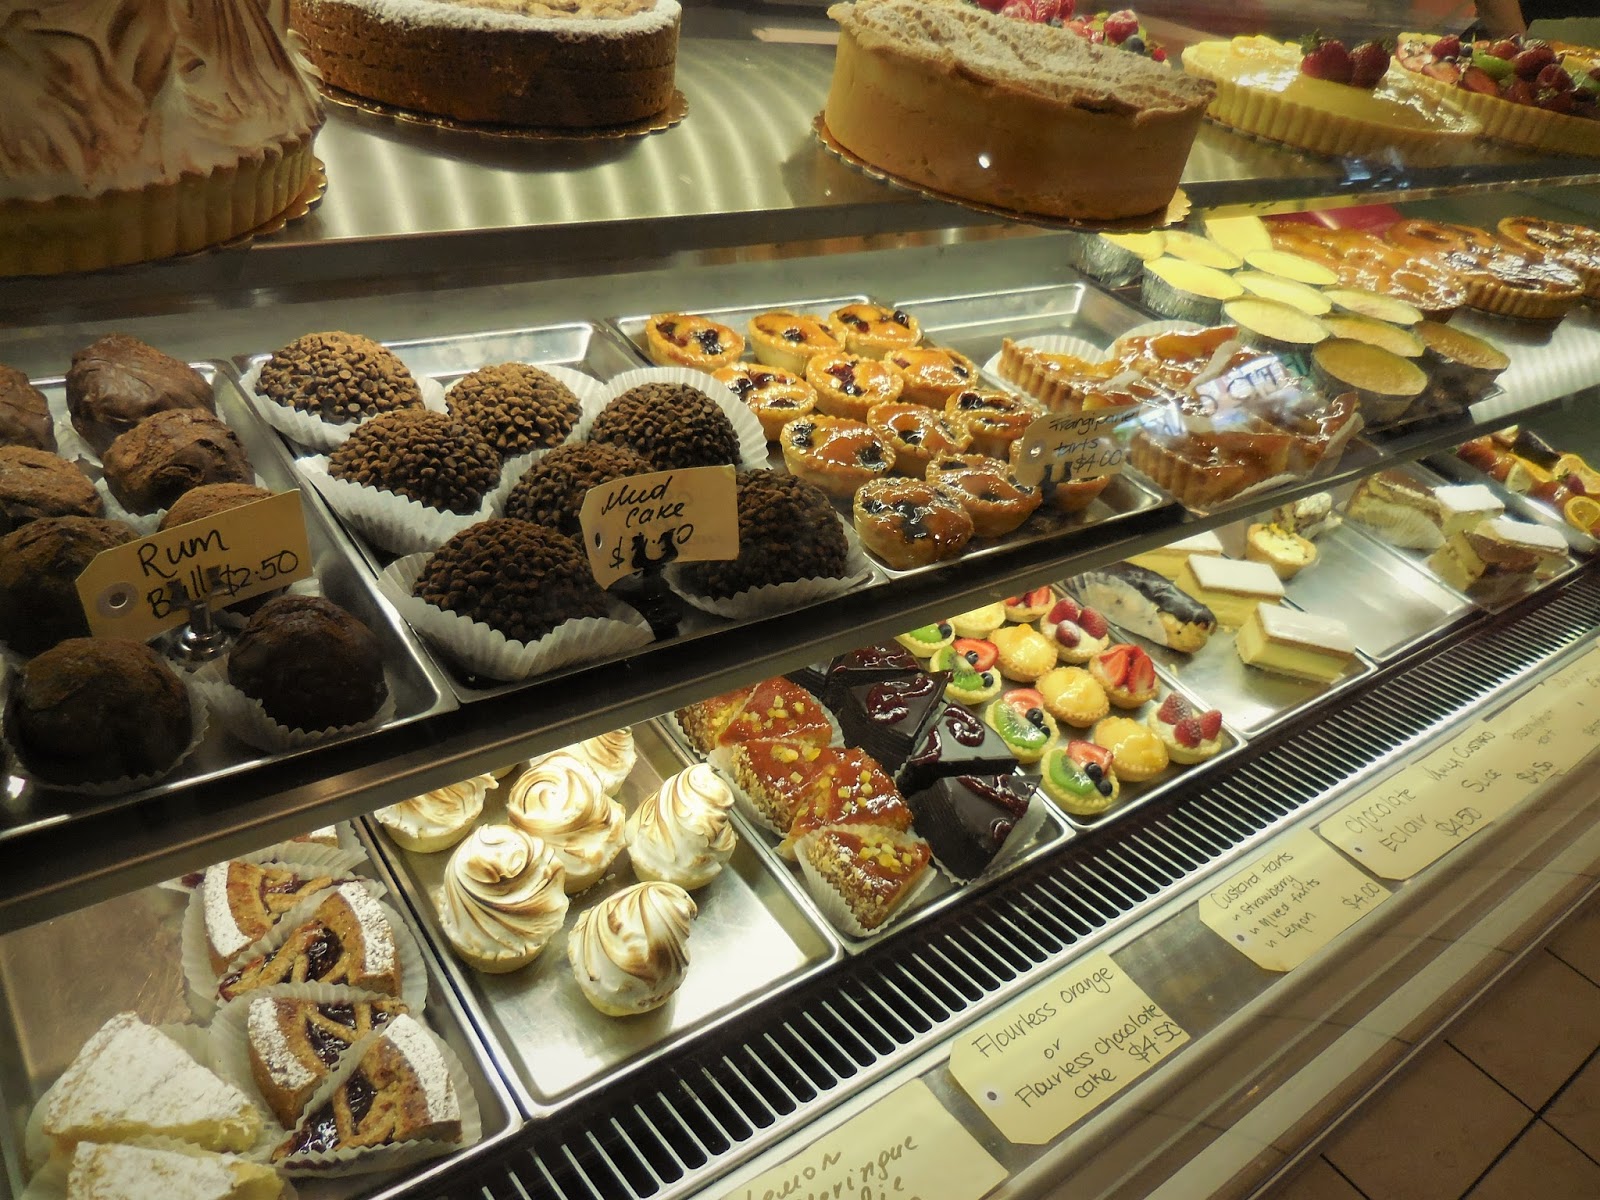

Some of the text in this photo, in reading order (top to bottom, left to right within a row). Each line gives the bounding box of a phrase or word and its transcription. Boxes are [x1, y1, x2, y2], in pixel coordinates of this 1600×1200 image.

[1053, 438, 1099, 454] tarts
[1072, 449, 1122, 473] $4.00
[601, 475, 673, 516] Mud
[137, 529, 230, 579] Rum
[147, 550, 299, 619] Bll $2.50
[1210, 852, 1294, 910] Custard tarts
[1342, 882, 1380, 910] $4.00
[971, 1002, 1056, 1058] Flourless
[1044, 1038, 1061, 1059] or
[1014, 1051, 1094, 1108] Flourless
[1074, 1067, 1117, 1098] cake
